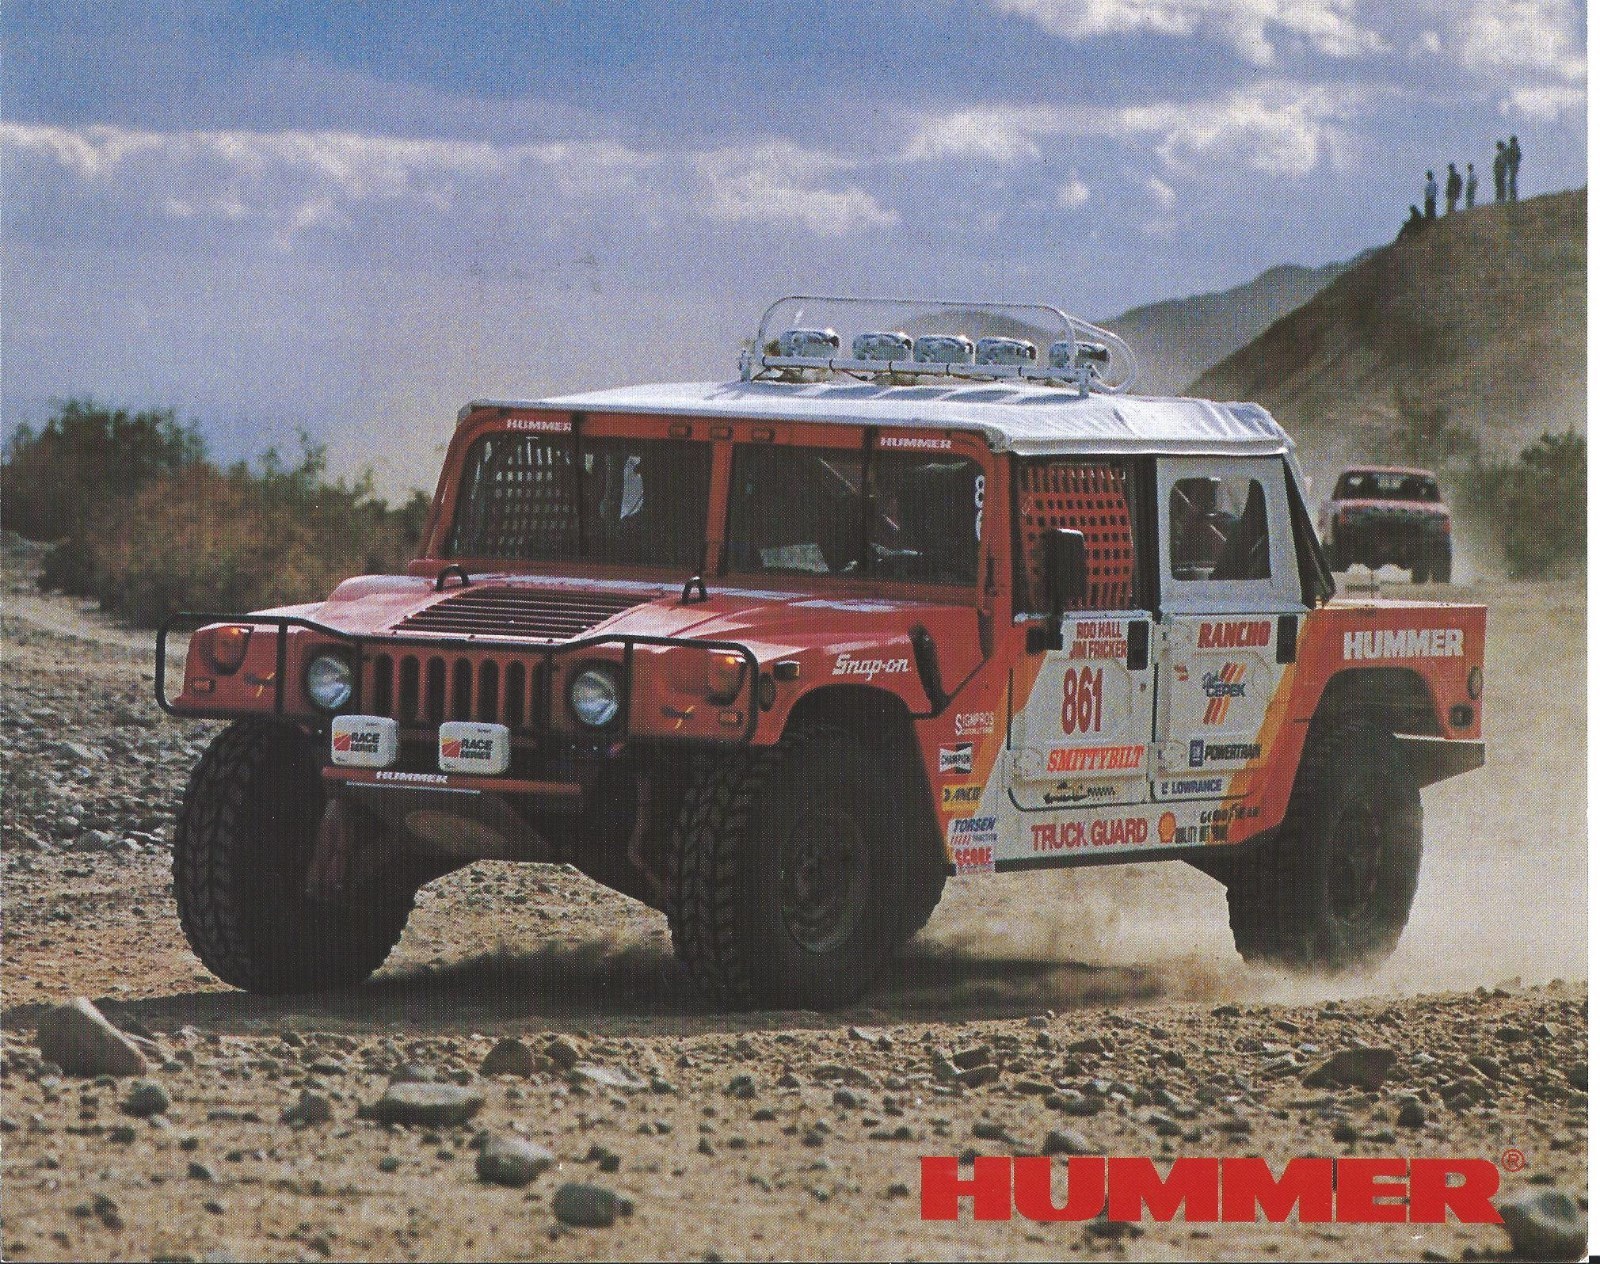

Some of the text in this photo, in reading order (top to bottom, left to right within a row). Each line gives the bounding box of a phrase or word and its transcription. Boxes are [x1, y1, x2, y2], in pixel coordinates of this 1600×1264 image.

[506, 418, 573, 432] HUMMER
[879, 436, 952, 450] HUMMER
[1098, 620, 1122, 638] HALL
[1197, 620, 1271, 648] RANCHO
[1343, 628, 1464, 660] HUMMER
[832, 653, 909, 682] Snap-on
[1061, 665, 1103, 735] 861
[351, 731, 380, 743] RACE
[461, 738, 493, 750] RACE
[1047, 744, 1145, 772] SMITTYBILT
[375, 771, 448, 784] HUMMER
[1171, 779, 1223, 794] LOWRANCE
[953, 817, 996, 833] TORSEN
[1031, 823, 1088, 851] TRUCK
[1090, 818, 1148, 846] GUARD
